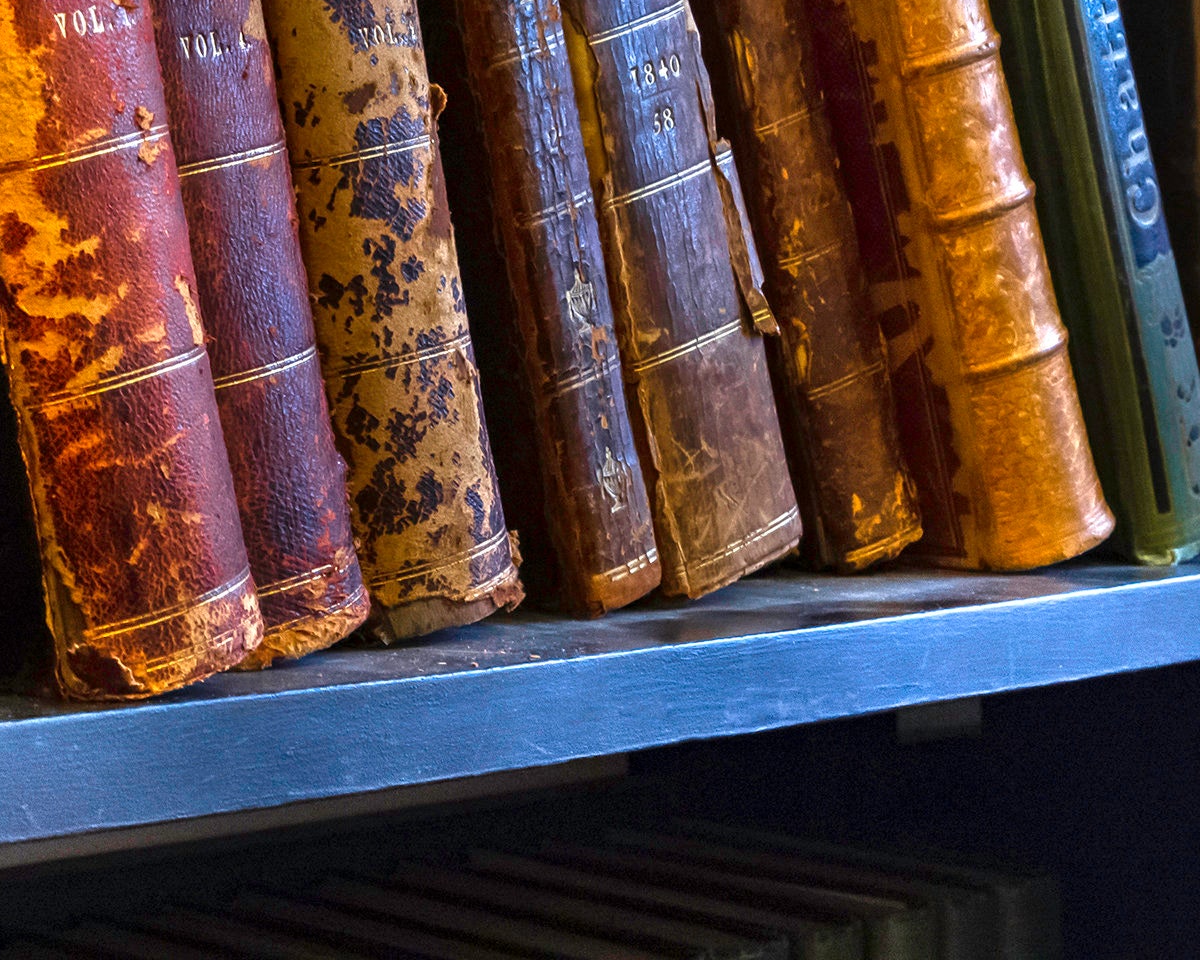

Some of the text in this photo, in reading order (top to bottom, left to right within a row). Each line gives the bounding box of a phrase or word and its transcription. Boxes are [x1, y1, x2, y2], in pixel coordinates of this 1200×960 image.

[54, 4, 114, 39] VOL.
[180, 31, 231, 59] VOL.
[630, 53, 680, 87] 1840
